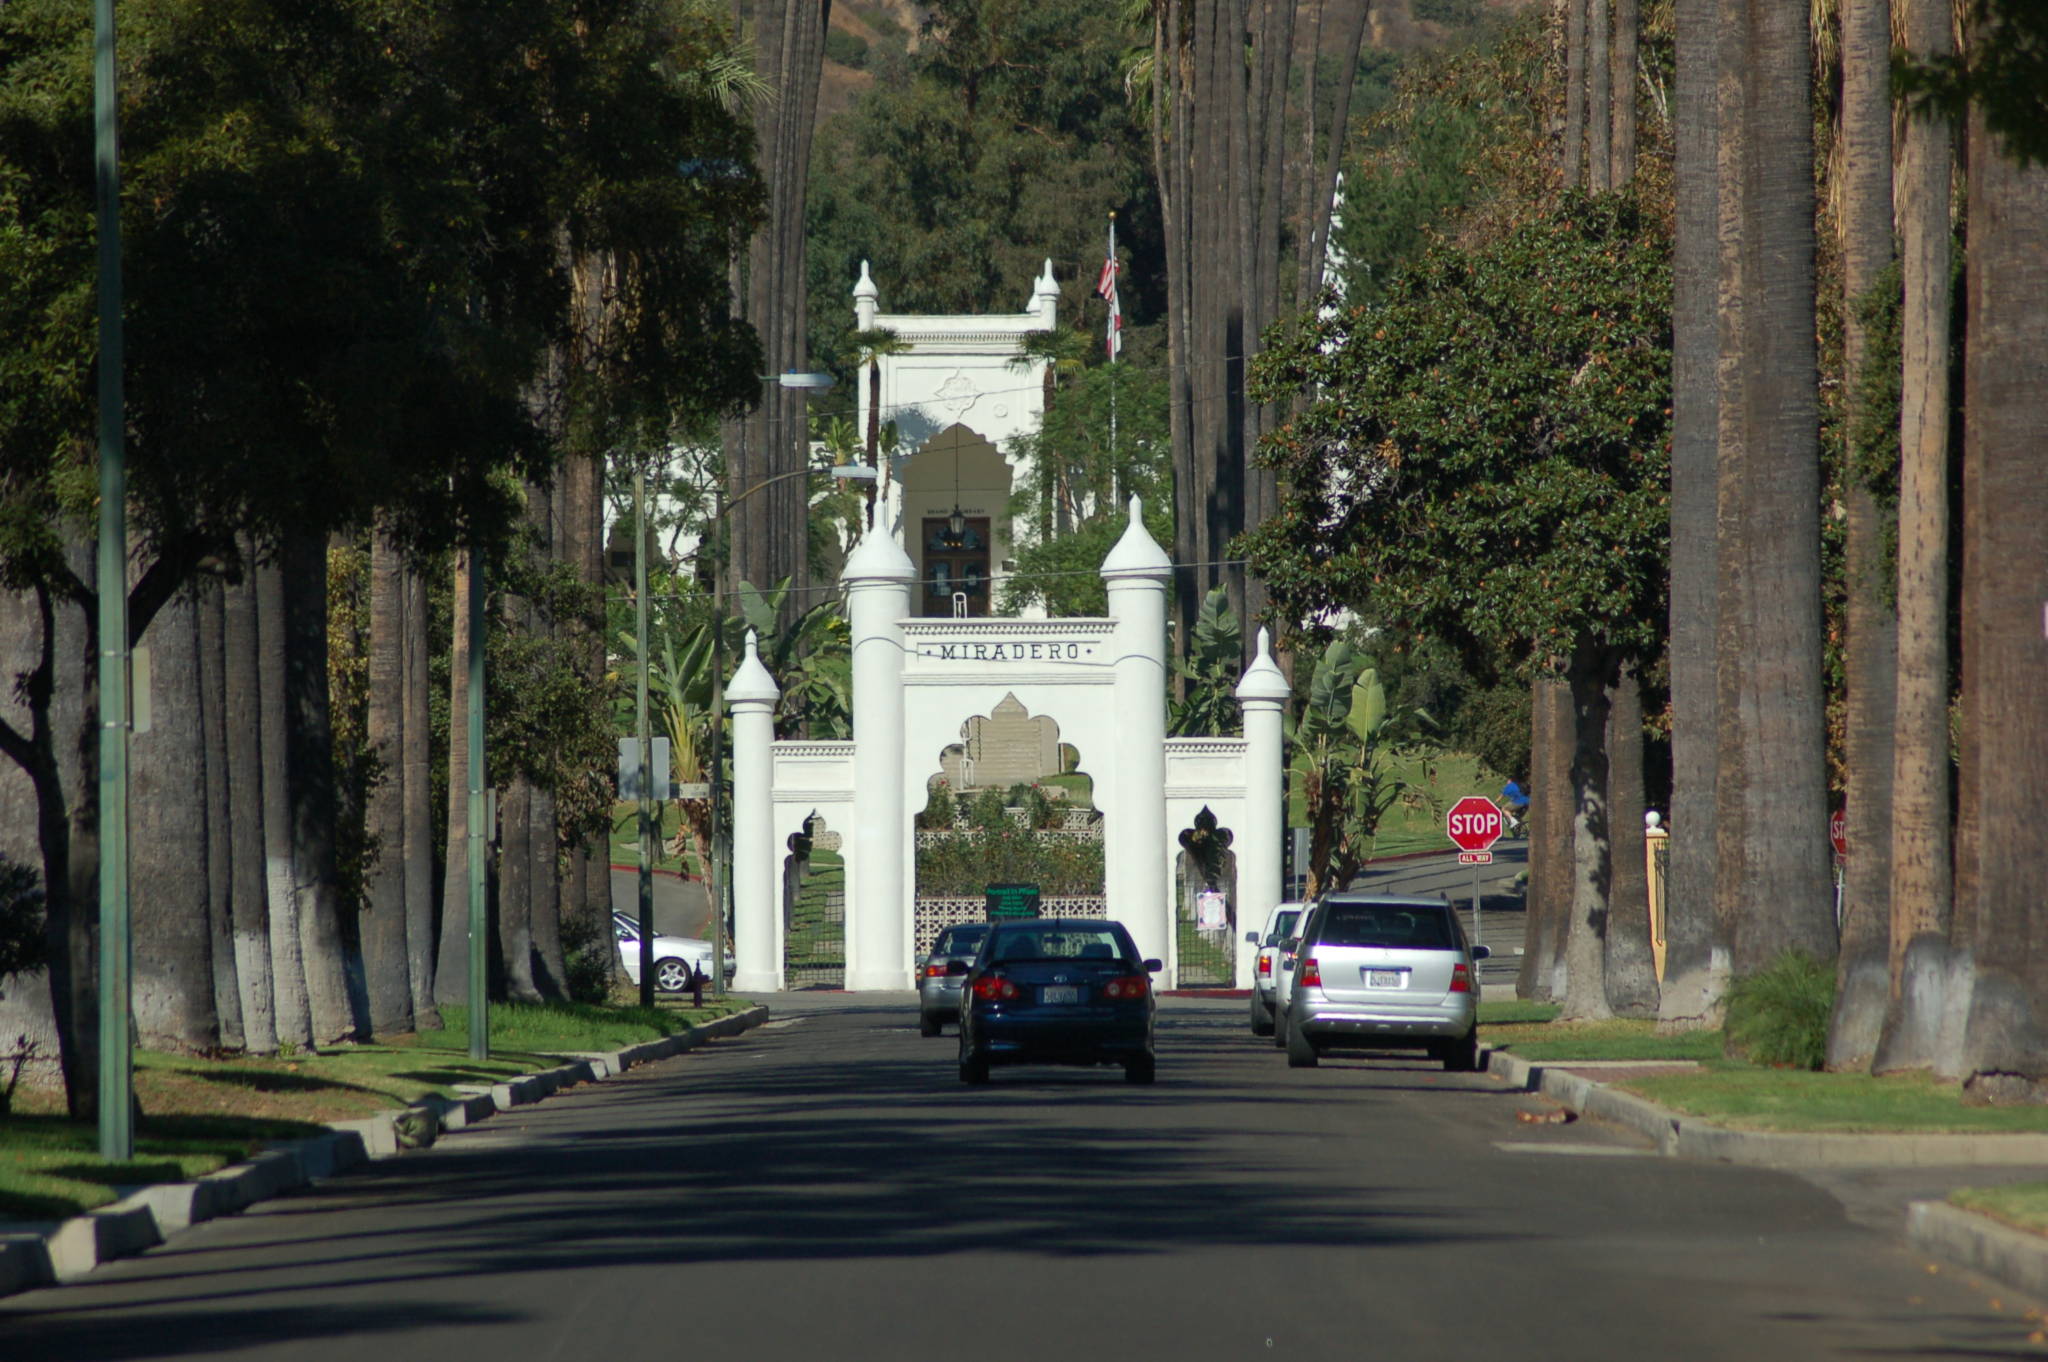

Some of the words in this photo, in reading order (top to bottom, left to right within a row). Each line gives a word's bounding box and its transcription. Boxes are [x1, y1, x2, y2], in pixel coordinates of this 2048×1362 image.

[940, 643, 1078, 661] MIRADERO
[1451, 813, 1499, 834] STOP
[1833, 821, 1846, 839] ST
[1461, 854, 1473, 862] ALL
[1476, 854, 1490, 862] WAY
